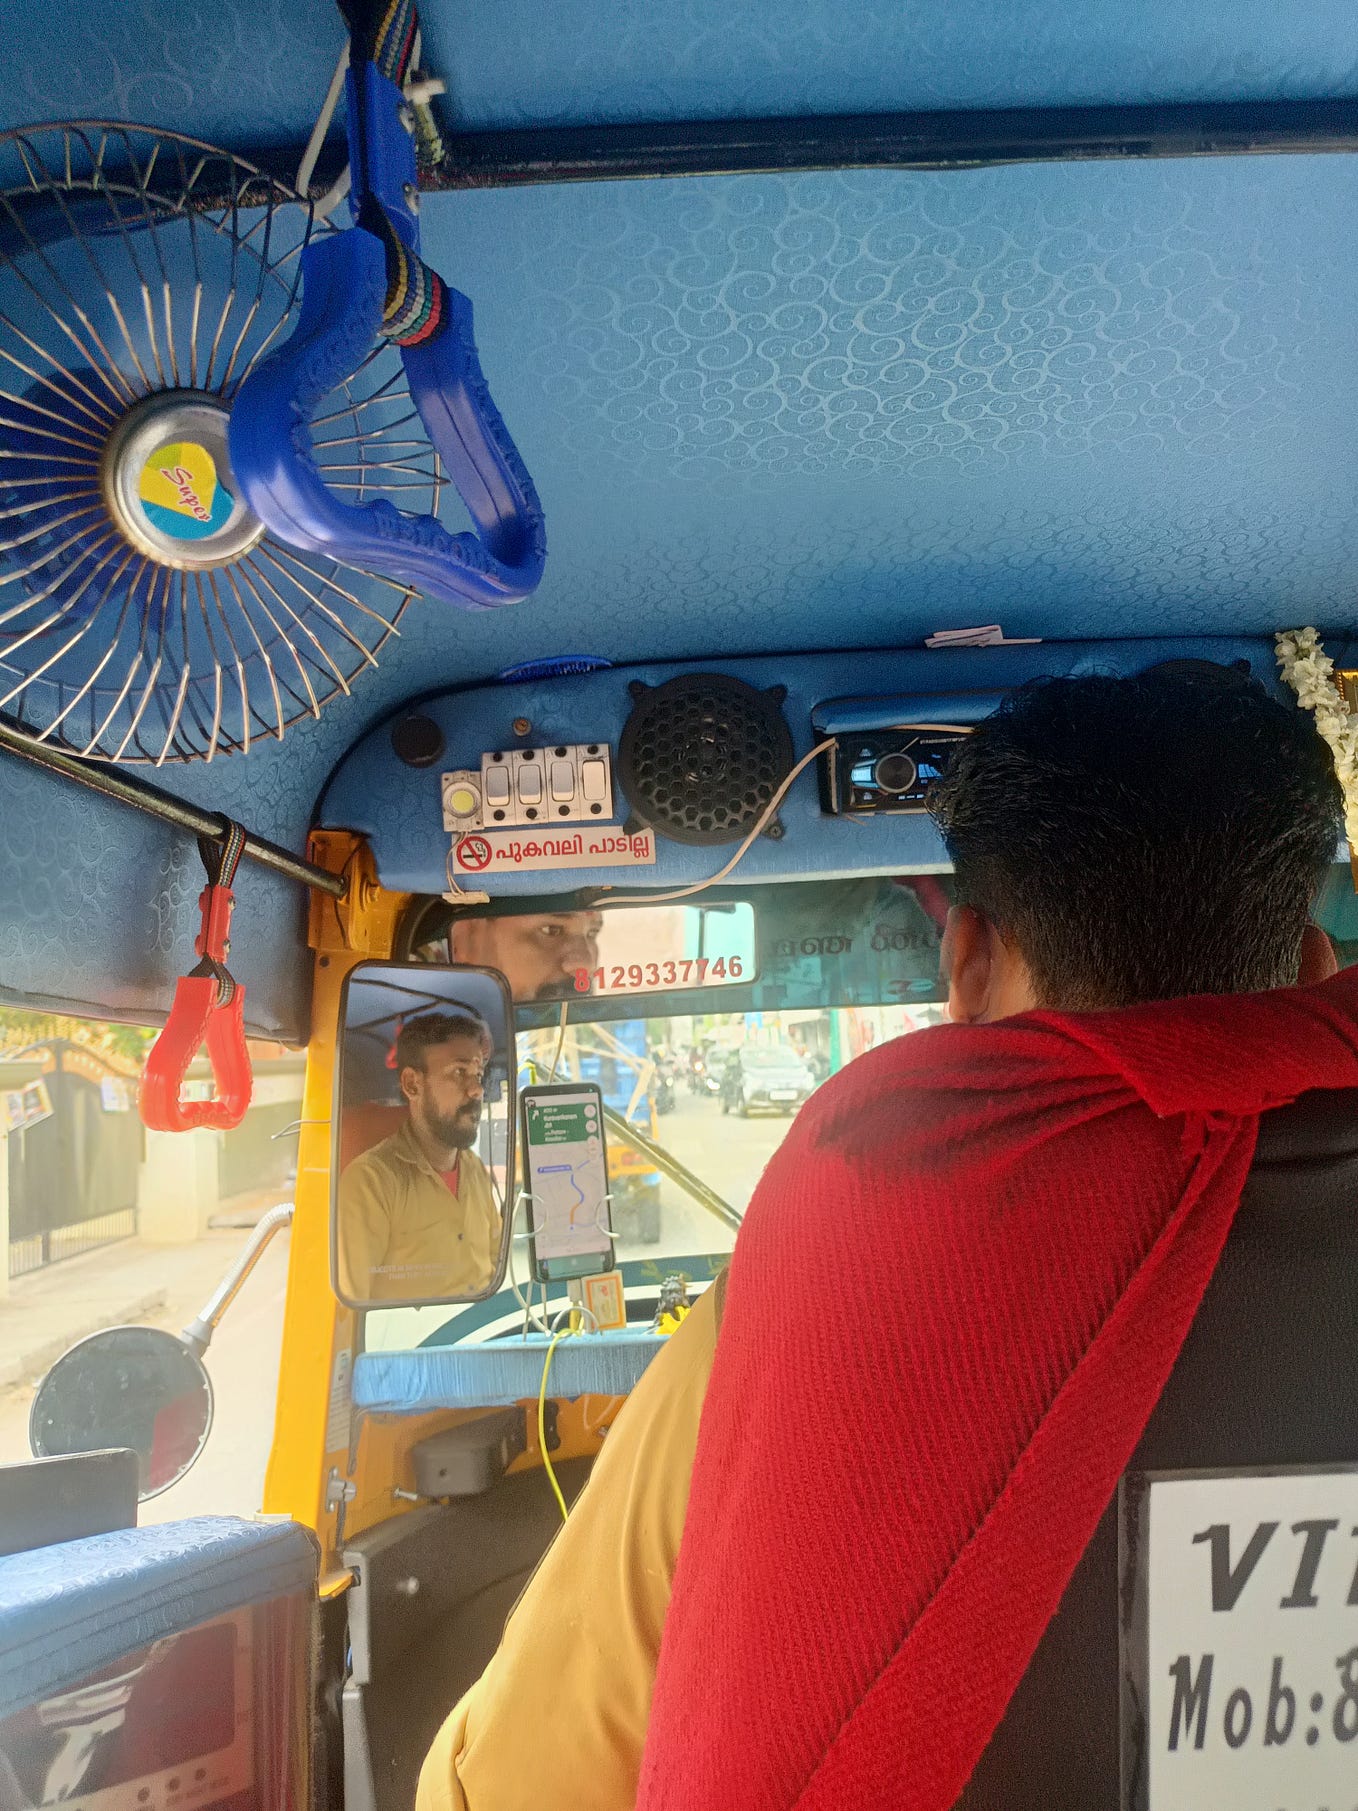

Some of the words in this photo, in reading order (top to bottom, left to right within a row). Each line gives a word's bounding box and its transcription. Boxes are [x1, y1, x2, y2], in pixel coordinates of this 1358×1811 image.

[161, 466, 212, 522] Super
[496, 834, 583, 863] പുകവലി
[589, 834, 650, 859] പാടില്ല
[573, 955, 743, 993] 8129337746
[1192, 1518, 1358, 1612] VI
